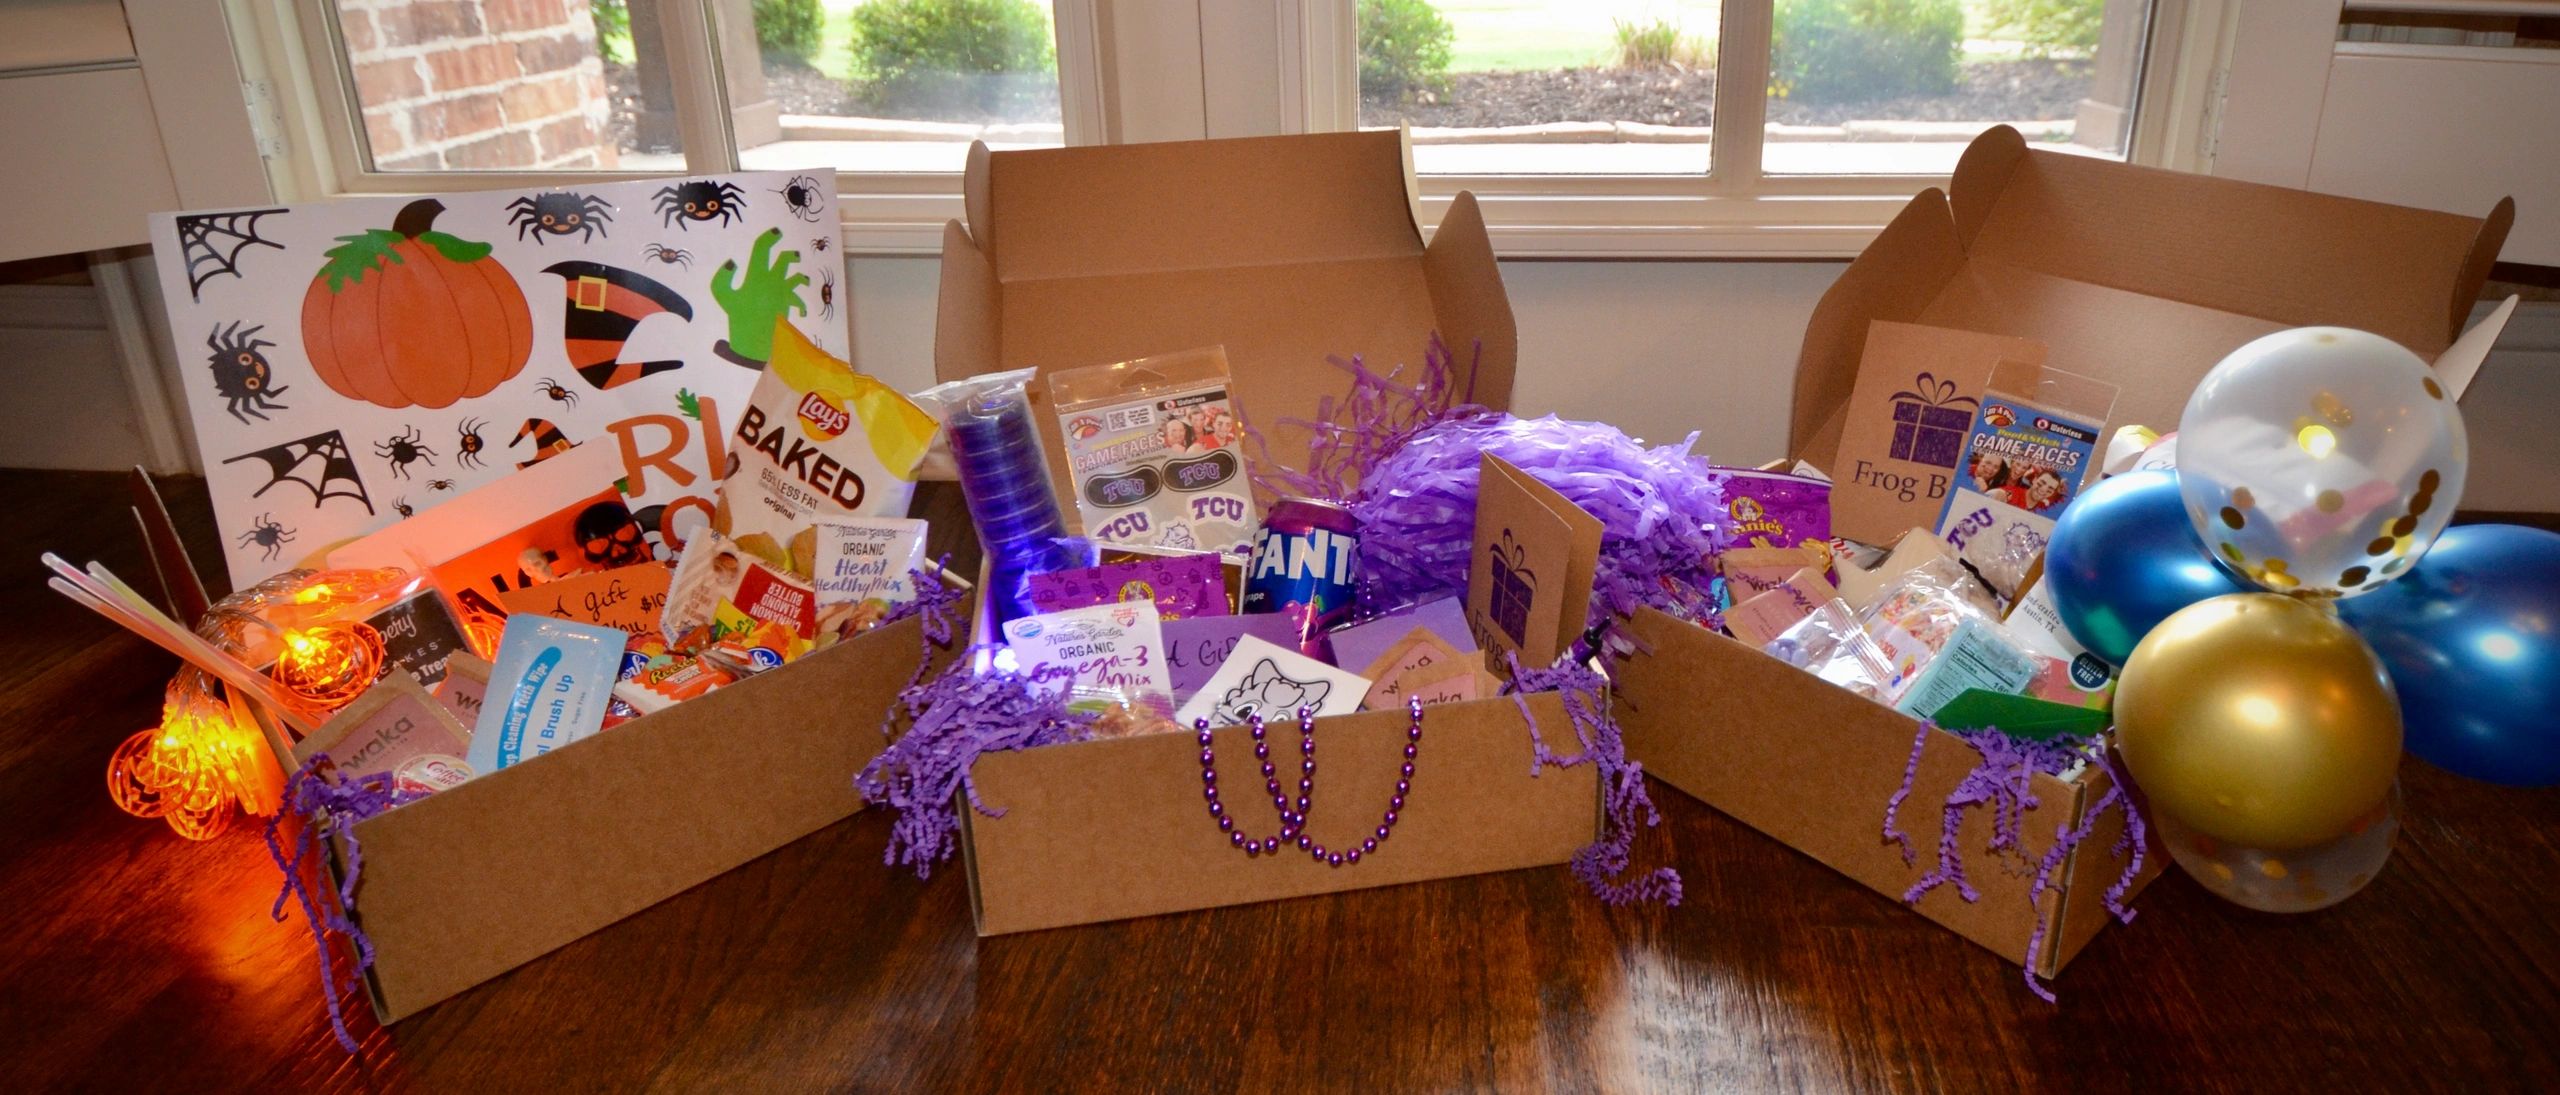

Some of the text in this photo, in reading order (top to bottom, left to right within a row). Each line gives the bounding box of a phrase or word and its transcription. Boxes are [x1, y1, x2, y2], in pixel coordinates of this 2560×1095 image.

[799, 394, 849, 430] Lay's
[737, 404, 865, 511] BAKED
[1075, 445, 1119, 470] GAME
[1121, 431, 1165, 457] FACES
[1973, 433, 2024, 455] GAME
[2024, 442, 2080, 467] FACES
[1179, 463, 1221, 486] TCU
[1852, 459, 1920, 503] Frog
[801, 493, 819, 510] FAT
[1103, 478, 1145, 502] TCU
[764, 496, 795, 520] original
[1191, 496, 1244, 521] TCU
[1097, 511, 1150, 541] TCU
[1735, 519, 1783, 536] nnie's
[1946, 507, 1995, 552] TCU
[843, 542, 886, 556] ORGANIC
[1249, 527, 1356, 586] FANT
[835, 558, 888, 577] Heart
[760, 593, 802, 618] ALMOND
[767, 582, 804, 605] BUTTER
[1059, 641, 1116, 660] ORGANIC
[1198, 636, 1240, 667] Gif
[1473, 608, 1504, 671] Frog
[1106, 672, 1152, 687] Mix
[2077, 667, 2095, 684] FREE
[541, 699, 565, 739] Brush
[555, 674, 575, 693] Up
[340, 716, 415, 770] waka
[503, 708, 527, 751] Cleaning
